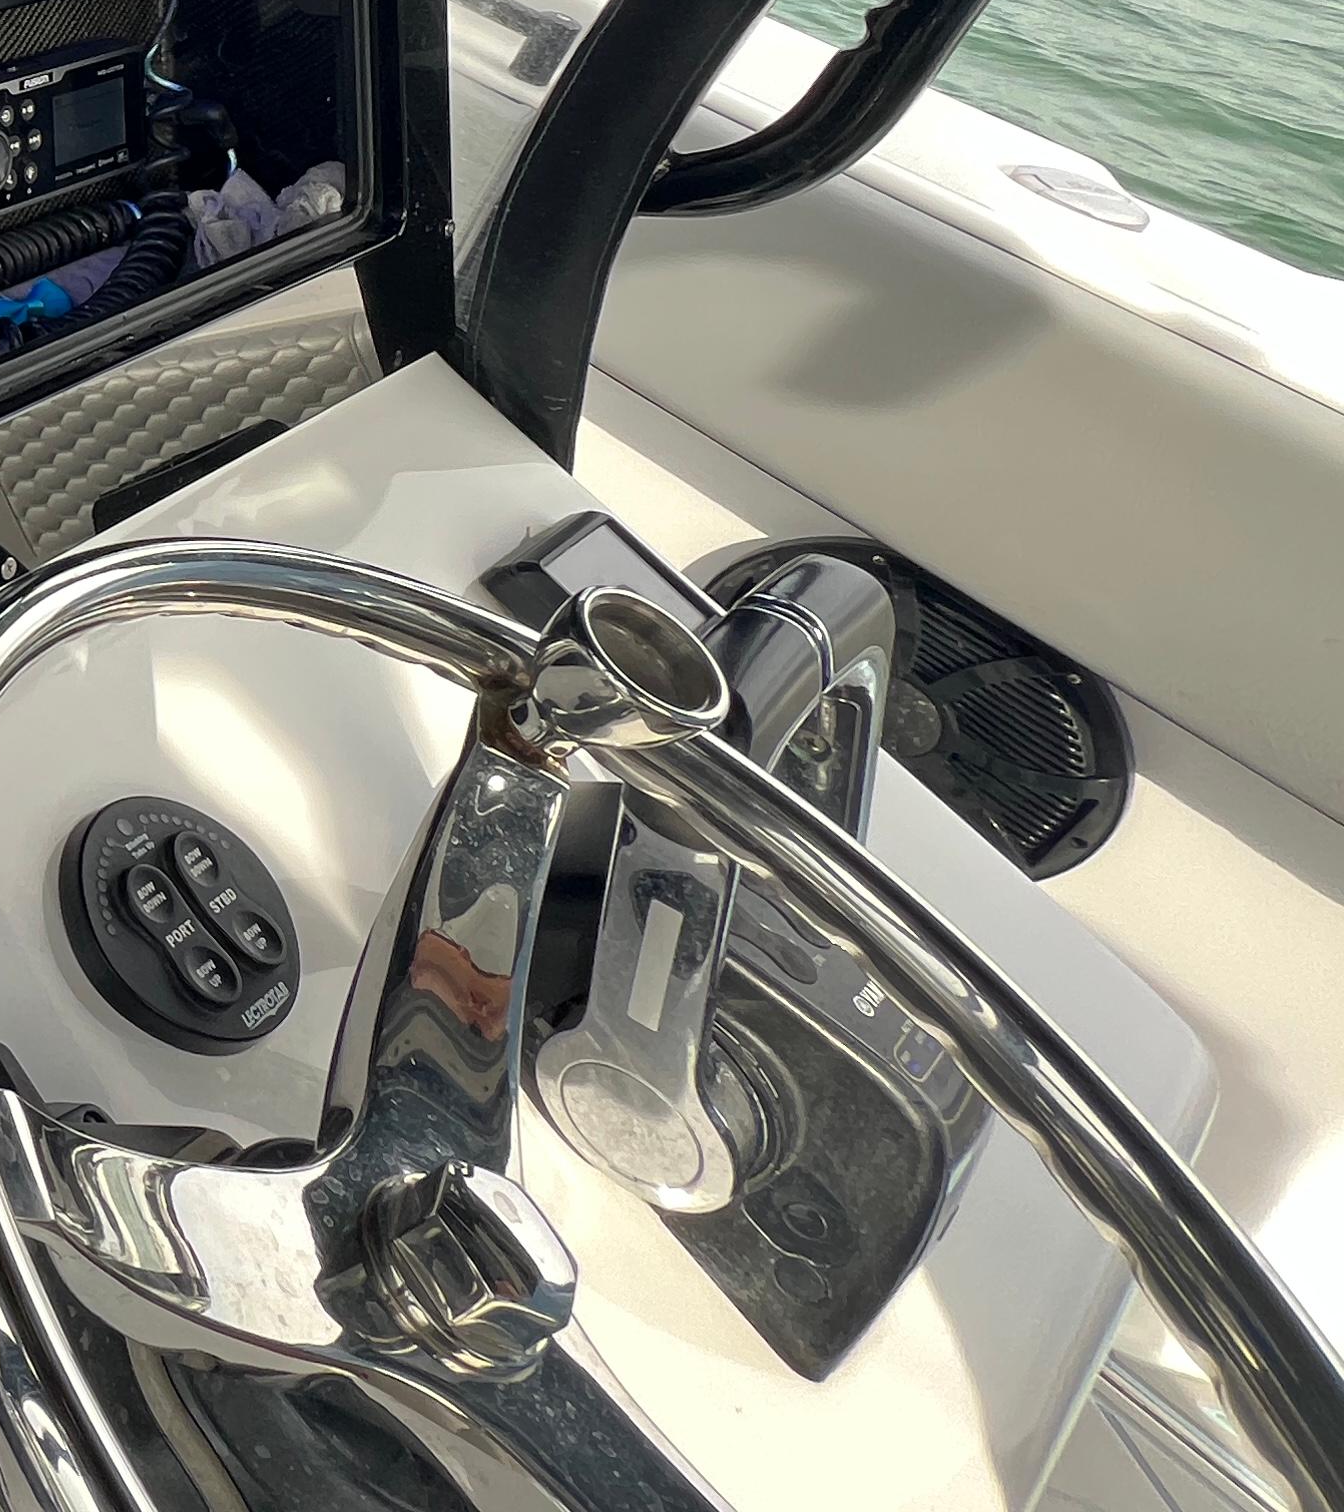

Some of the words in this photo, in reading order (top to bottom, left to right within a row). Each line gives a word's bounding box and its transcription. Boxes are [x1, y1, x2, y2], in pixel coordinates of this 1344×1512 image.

[143, 891, 167, 913] DOWN
[209, 888, 237, 913] STBD
[165, 919, 196, 948] PORT
